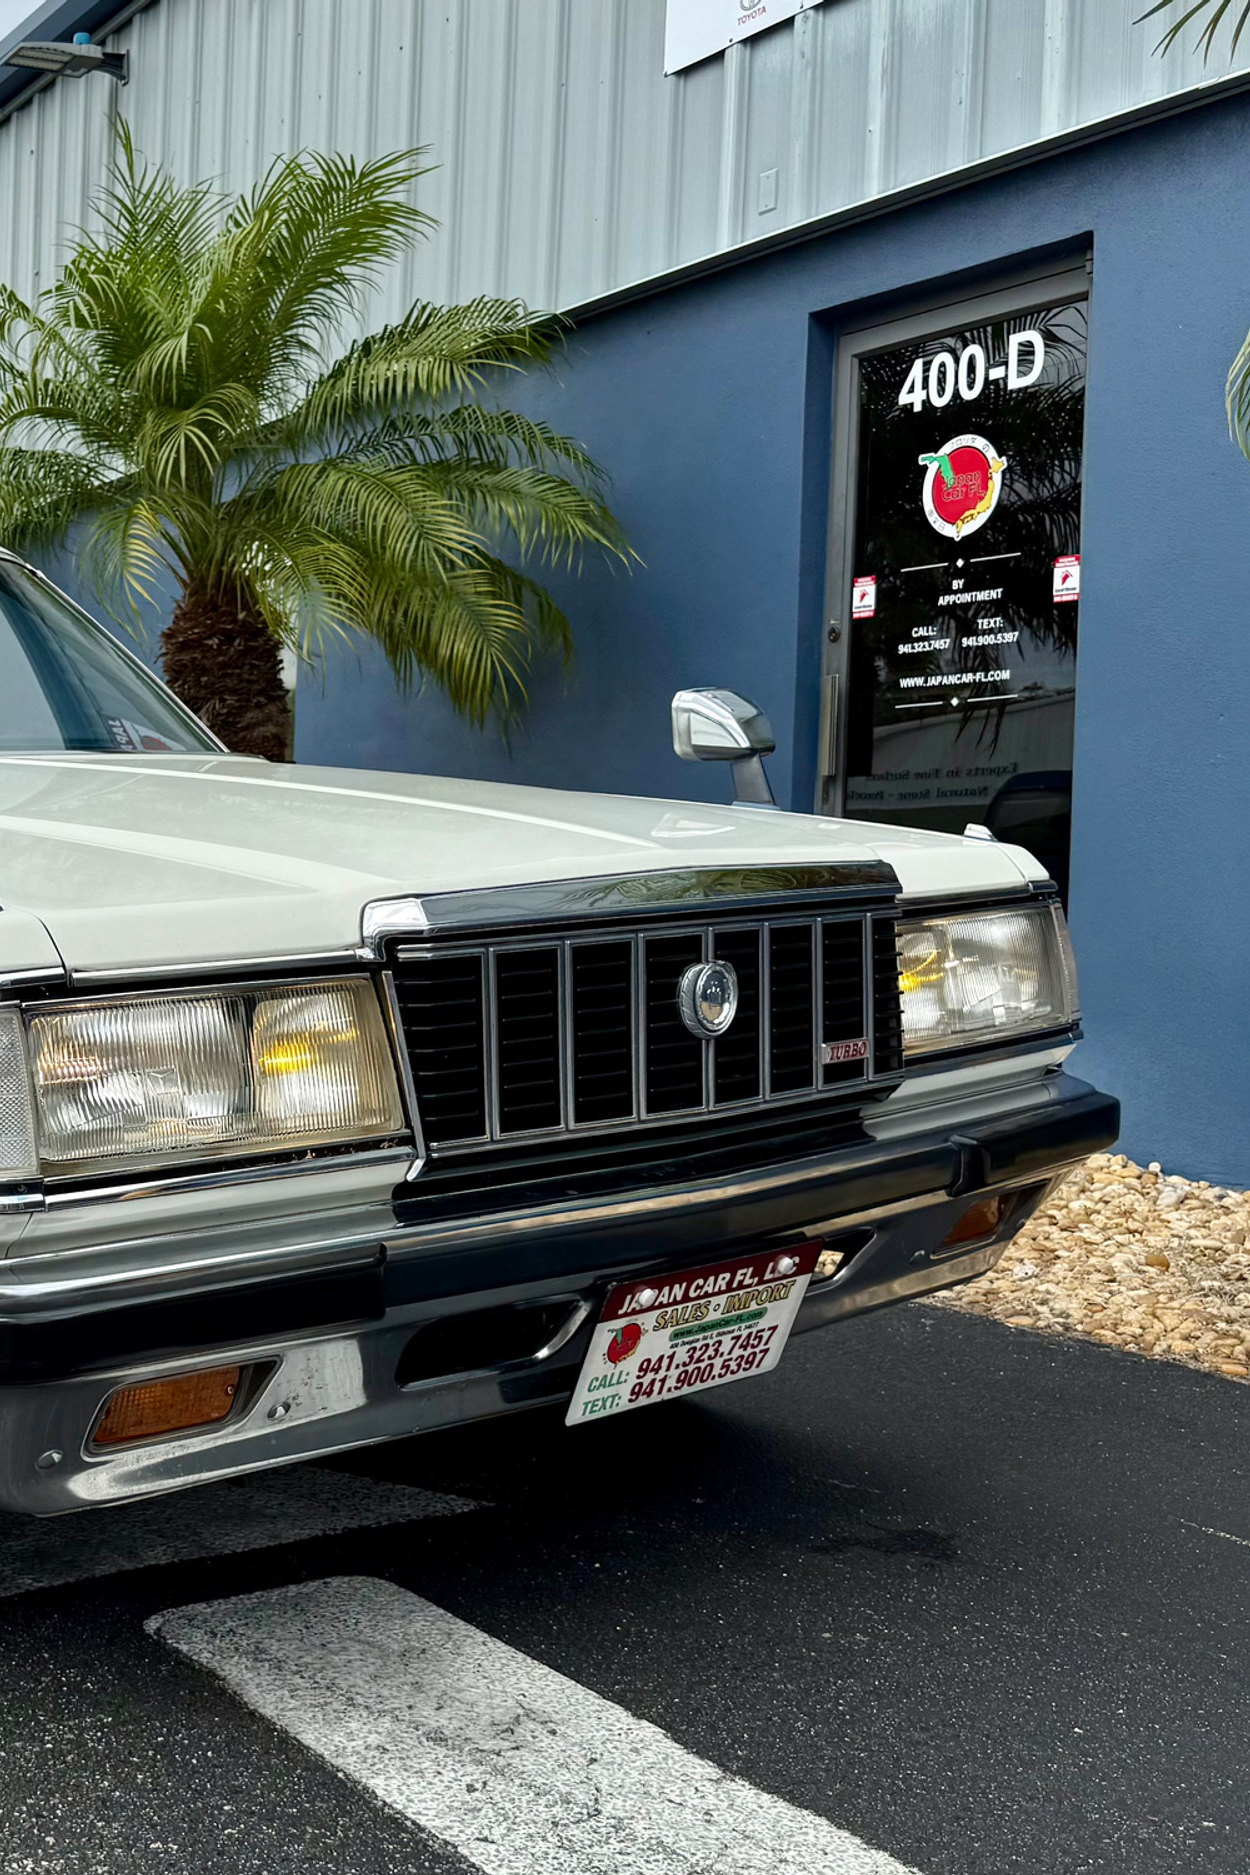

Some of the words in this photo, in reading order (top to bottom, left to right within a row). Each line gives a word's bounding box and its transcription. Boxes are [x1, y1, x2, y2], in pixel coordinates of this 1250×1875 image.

[737, 5, 766, 26] TOYOTA
[898, 329, 1045, 413] 400-D
[942, 471, 981, 490] Japan
[942, 487, 966, 502] Car
[968, 483, 985, 498] FL
[952, 578, 965, 590] BY
[937, 588, 1003, 606] APPOINTMENT
[912, 626, 937, 637] CALL:
[977, 617, 1003, 630] TEXT:
[897, 638, 950, 655] 941.323.7457
[962, 631, 1019, 648] 941.900.5397
[899, 669, 1010, 688] WWW.JAPANCAR-FL.COM
[829, 1041, 868, 1061] TURBO
[689, 1271, 731, 1299] CAR
[732, 1267, 758, 1288] FL,
[652, 1301, 711, 1332] SALES
[721, 1279, 797, 1315] IMPORT
[588, 1370, 630, 1392] CALL:
[635, 1325, 779, 1381] 941.323.7457
[582, 1392, 622, 1417] TEXT:
[628, 1347, 770, 1404] 941.900.5397
